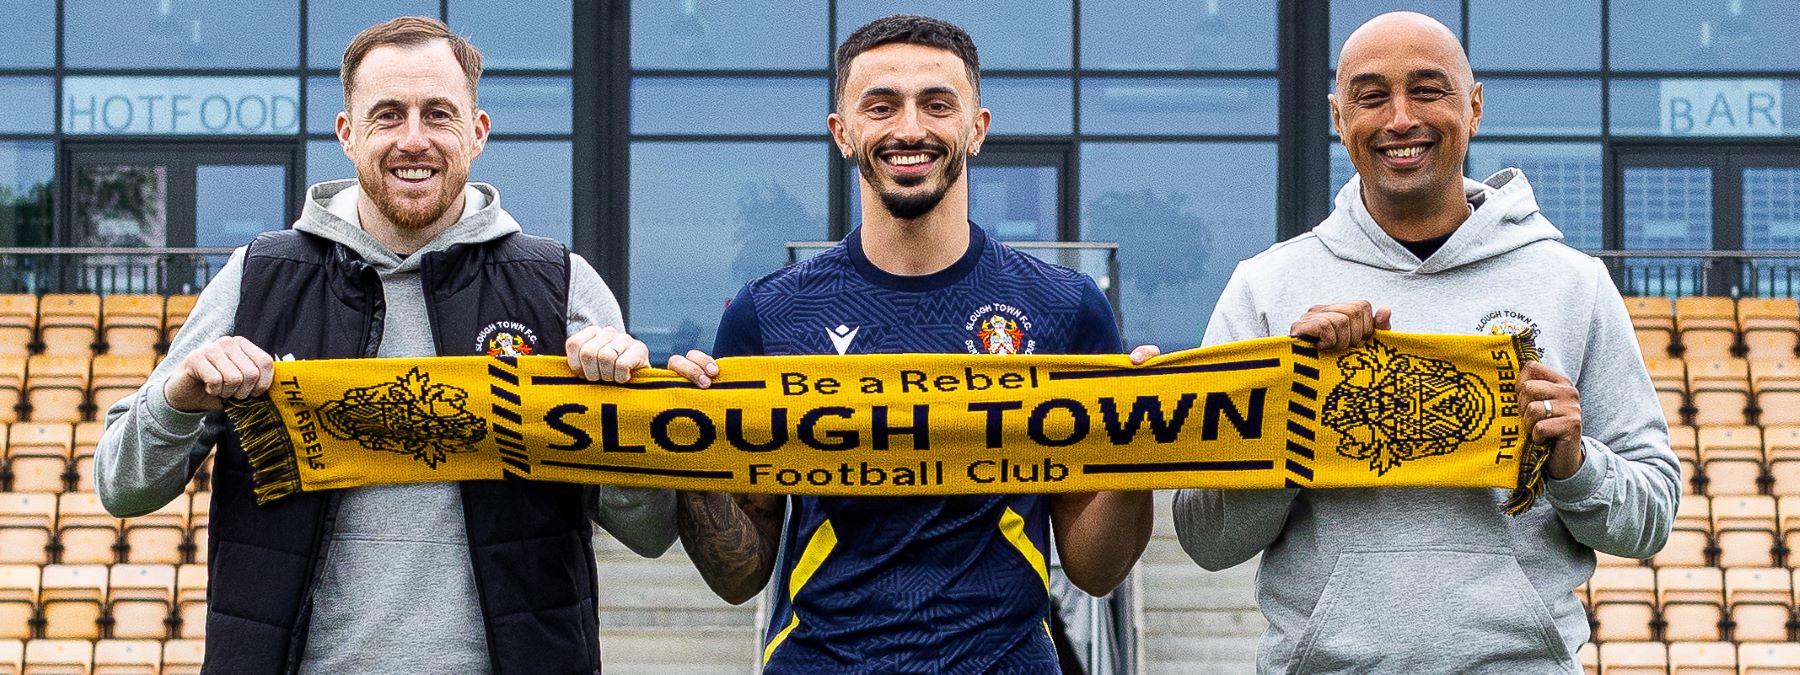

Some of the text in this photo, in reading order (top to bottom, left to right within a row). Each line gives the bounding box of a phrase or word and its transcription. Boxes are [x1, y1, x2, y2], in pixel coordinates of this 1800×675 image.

[1670, 89, 1777, 133] BAR
[965, 304, 993, 331] SLOUGH
[993, 302, 1022, 318] TOWN
[1475, 310, 1502, 332] SLOUGH
[1503, 310, 1532, 324] TOWN
[475, 323, 497, 352] SLOUGH
[496, 320, 526, 333] TOWN
[280, 376, 306, 407] TH
[781, 366, 1039, 396] Be a Rebel
[543, 387, 1268, 453] SLOUGH TOWN
[1491, 350, 1519, 464] THE REBELS
[749, 458, 1069, 487] Football Club
